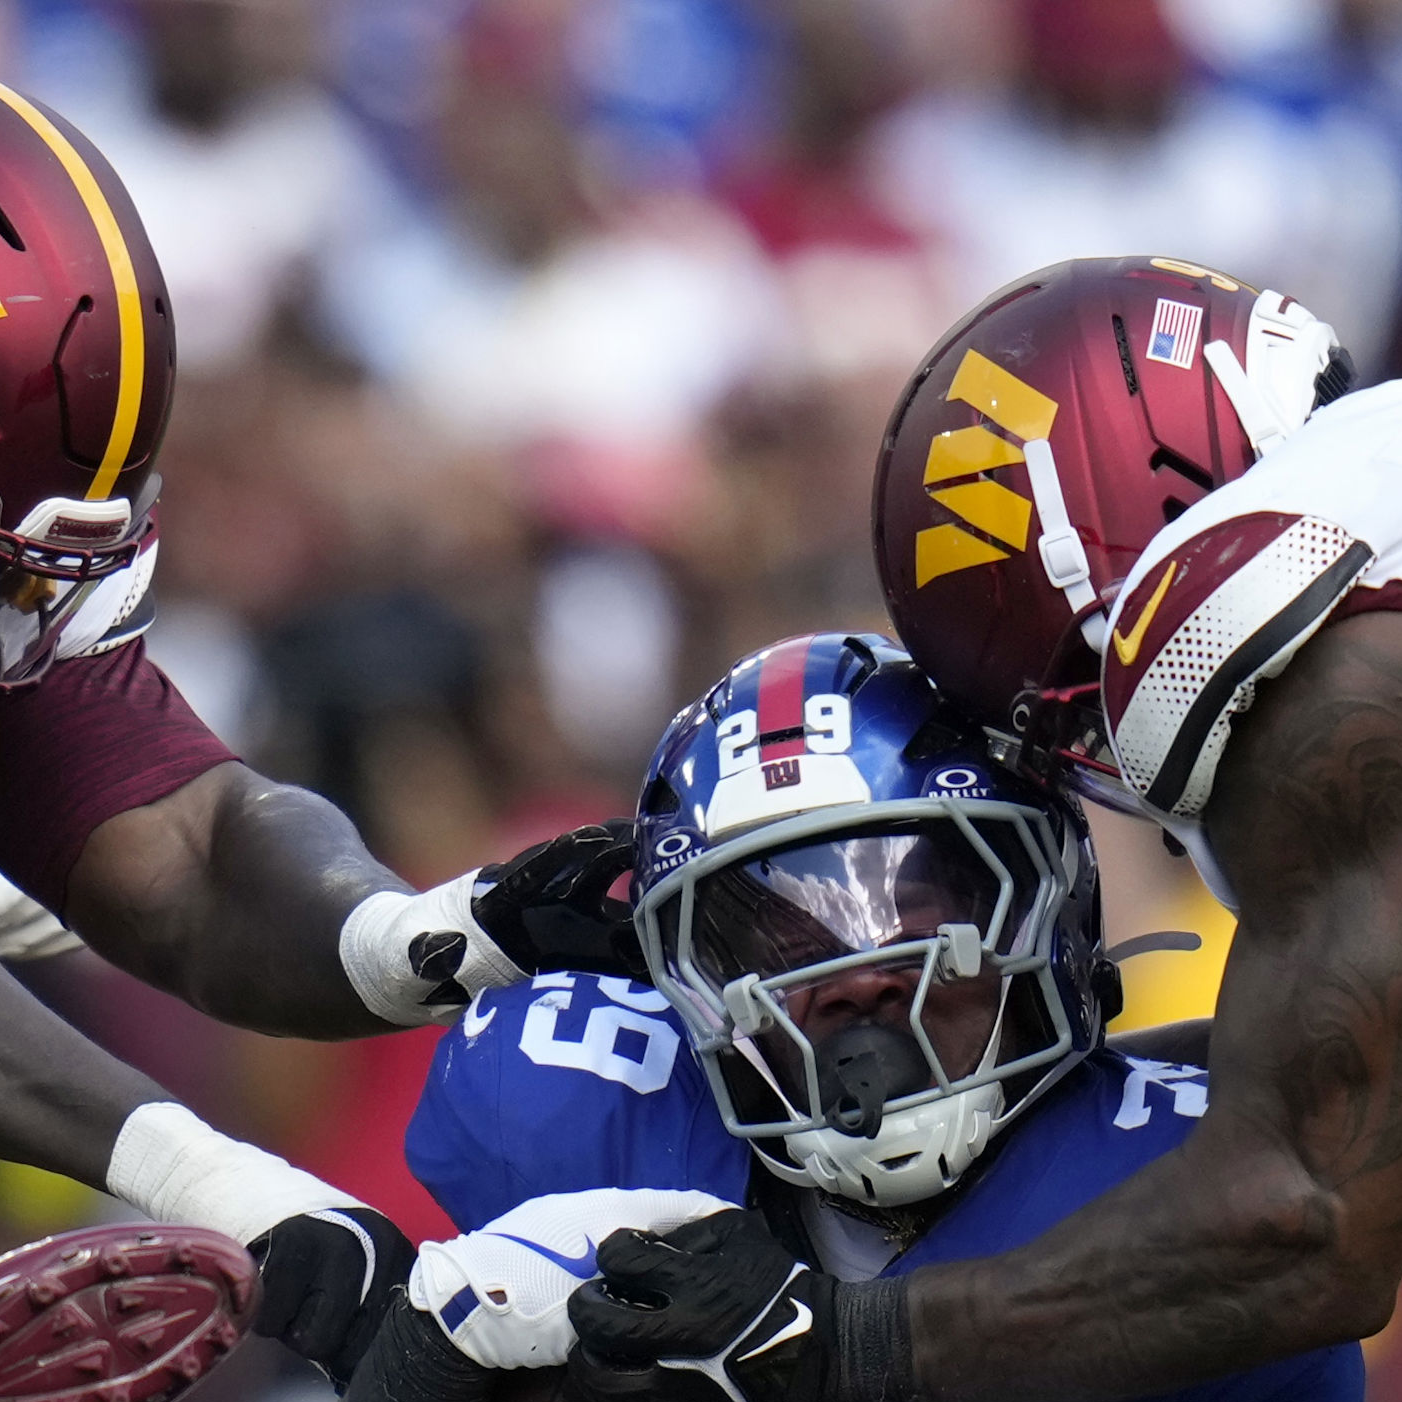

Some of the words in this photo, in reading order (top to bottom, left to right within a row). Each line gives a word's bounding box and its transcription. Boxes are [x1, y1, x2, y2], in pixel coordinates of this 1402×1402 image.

[716, 694, 852, 778] 29
[929, 787, 990, 799] OAKLEY
[653, 846, 705, 873] OAKLEY
